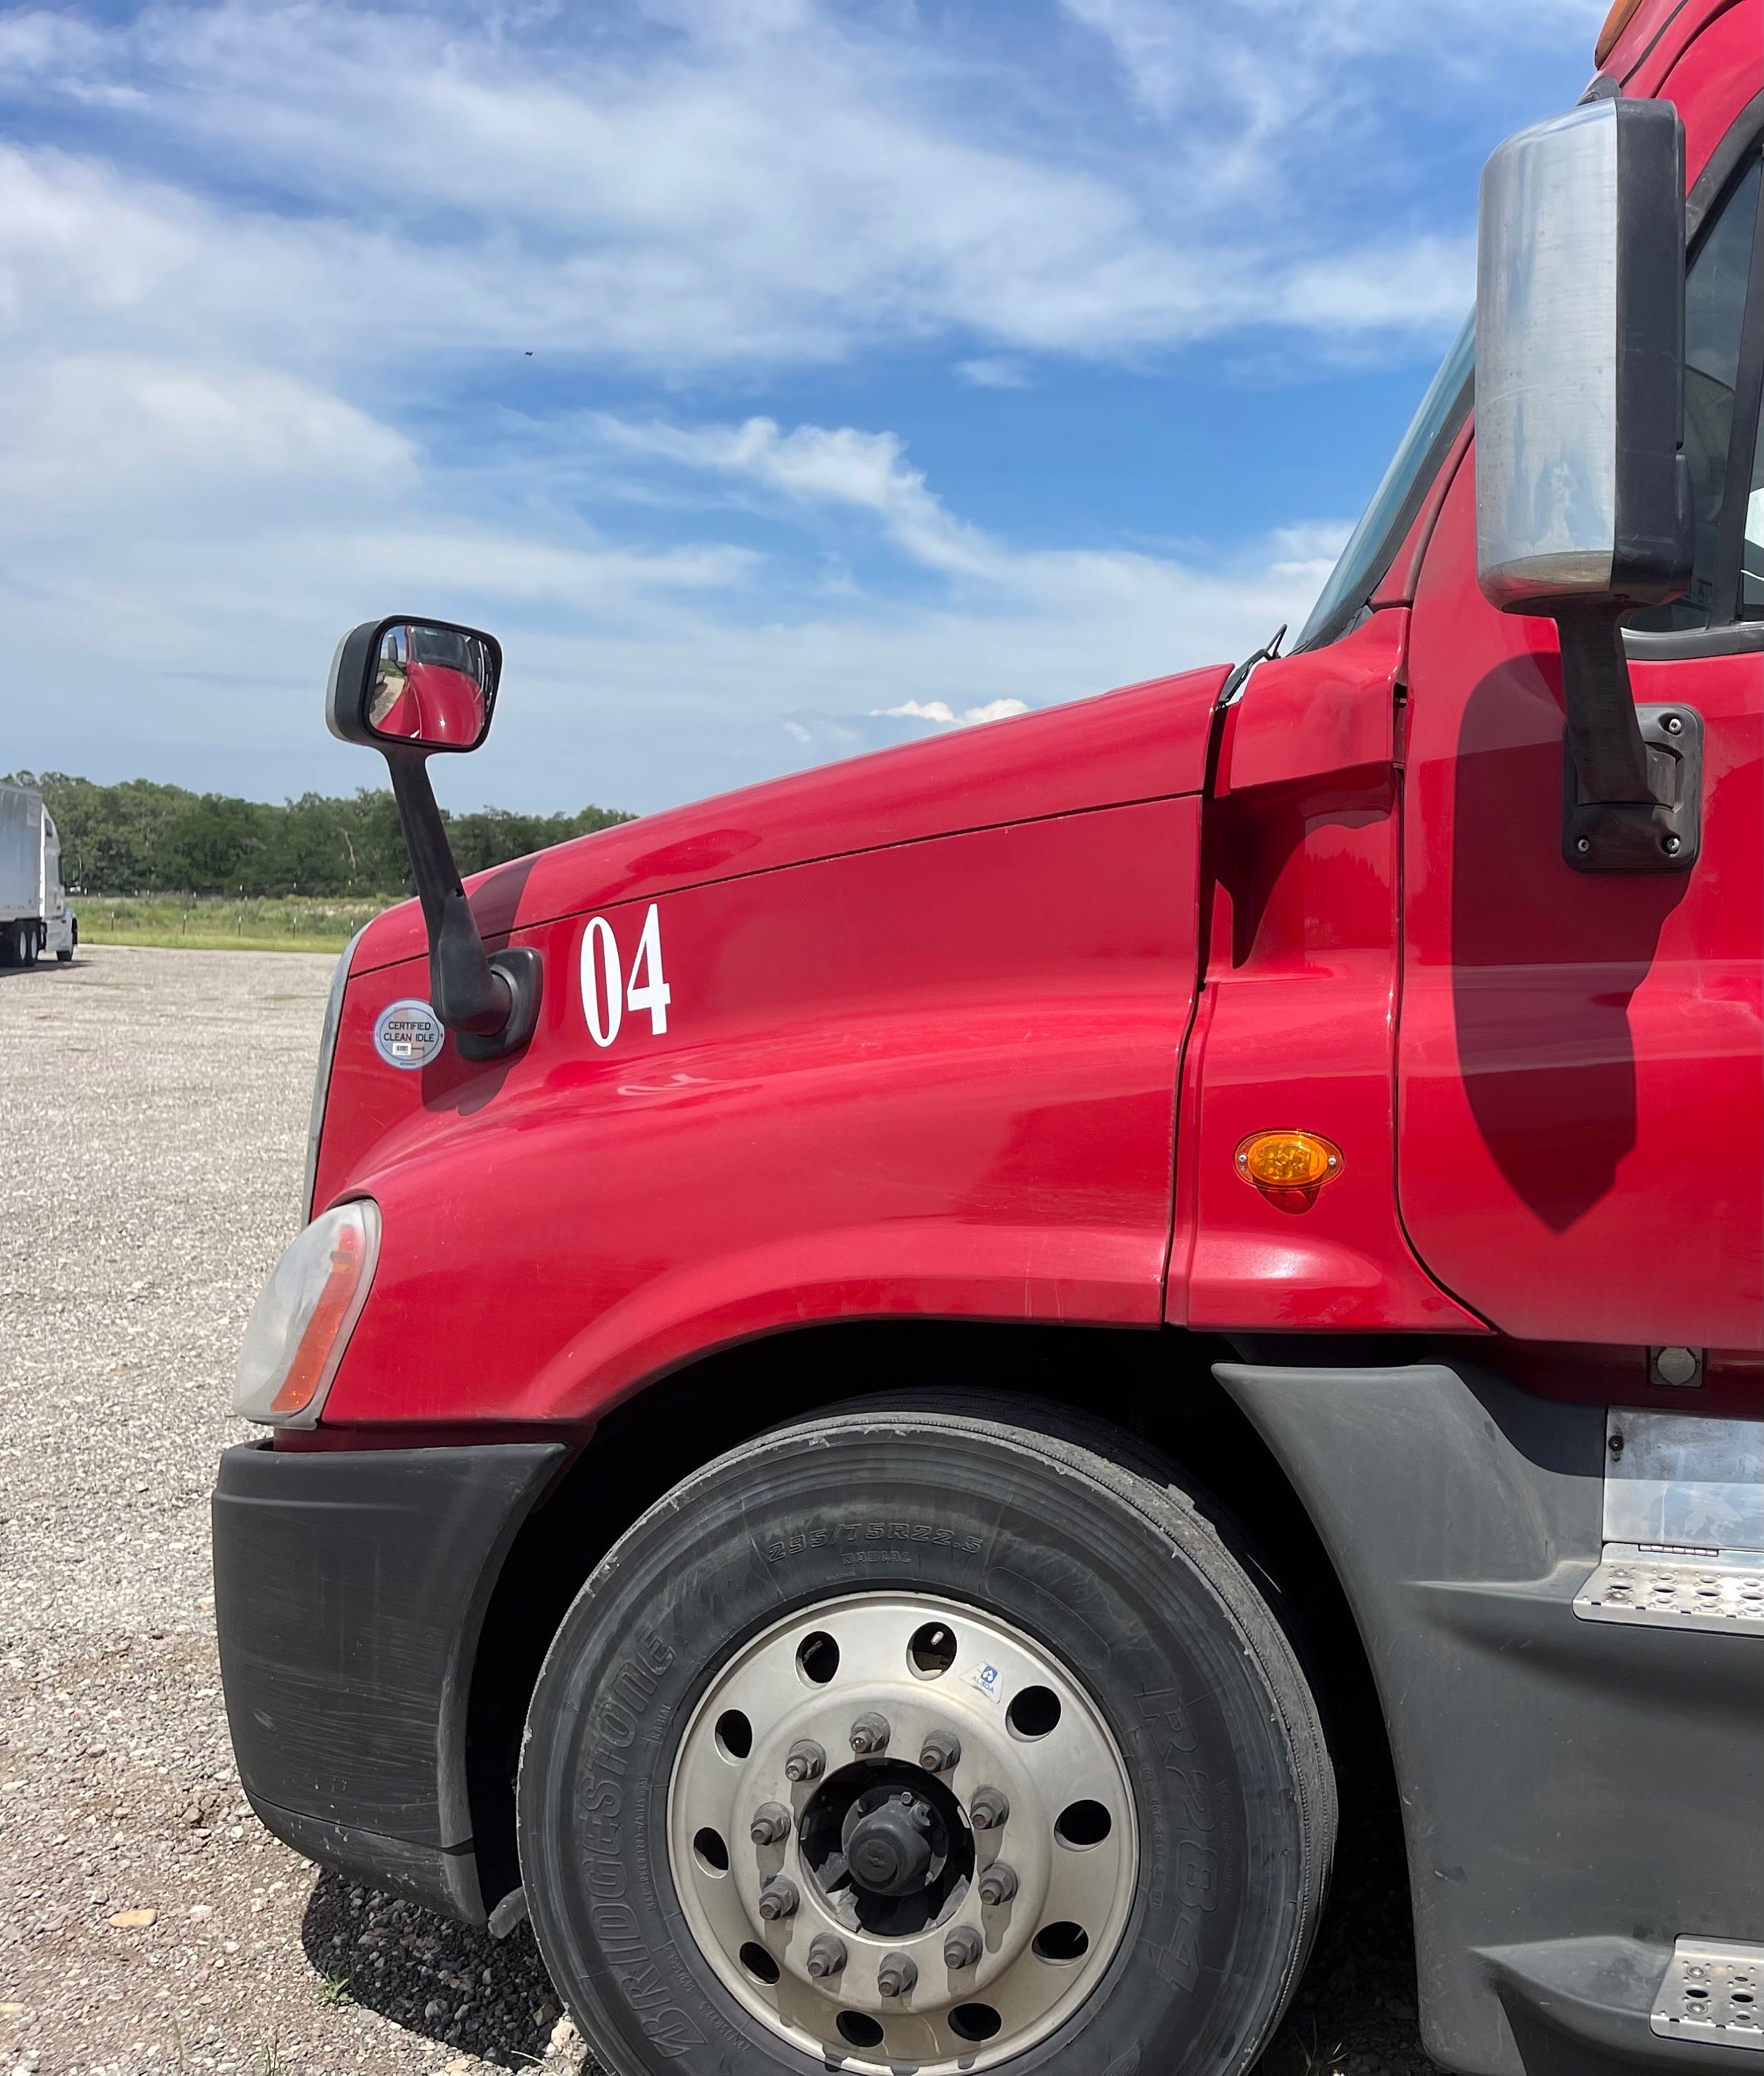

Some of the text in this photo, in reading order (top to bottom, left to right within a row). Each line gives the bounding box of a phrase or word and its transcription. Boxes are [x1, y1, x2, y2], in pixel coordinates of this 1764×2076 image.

[580, 902, 671, 1048] 04
[383, 1032, 435, 1042] CLEAN IDLE
[388, 1021, 430, 1030] CERTIFIED
[767, 1522, 984, 1563] 295/75R22.5
[840, 1549, 911, 1565] RADIAL
[581, 1629, 709, 2059] BRIDGESTONE
